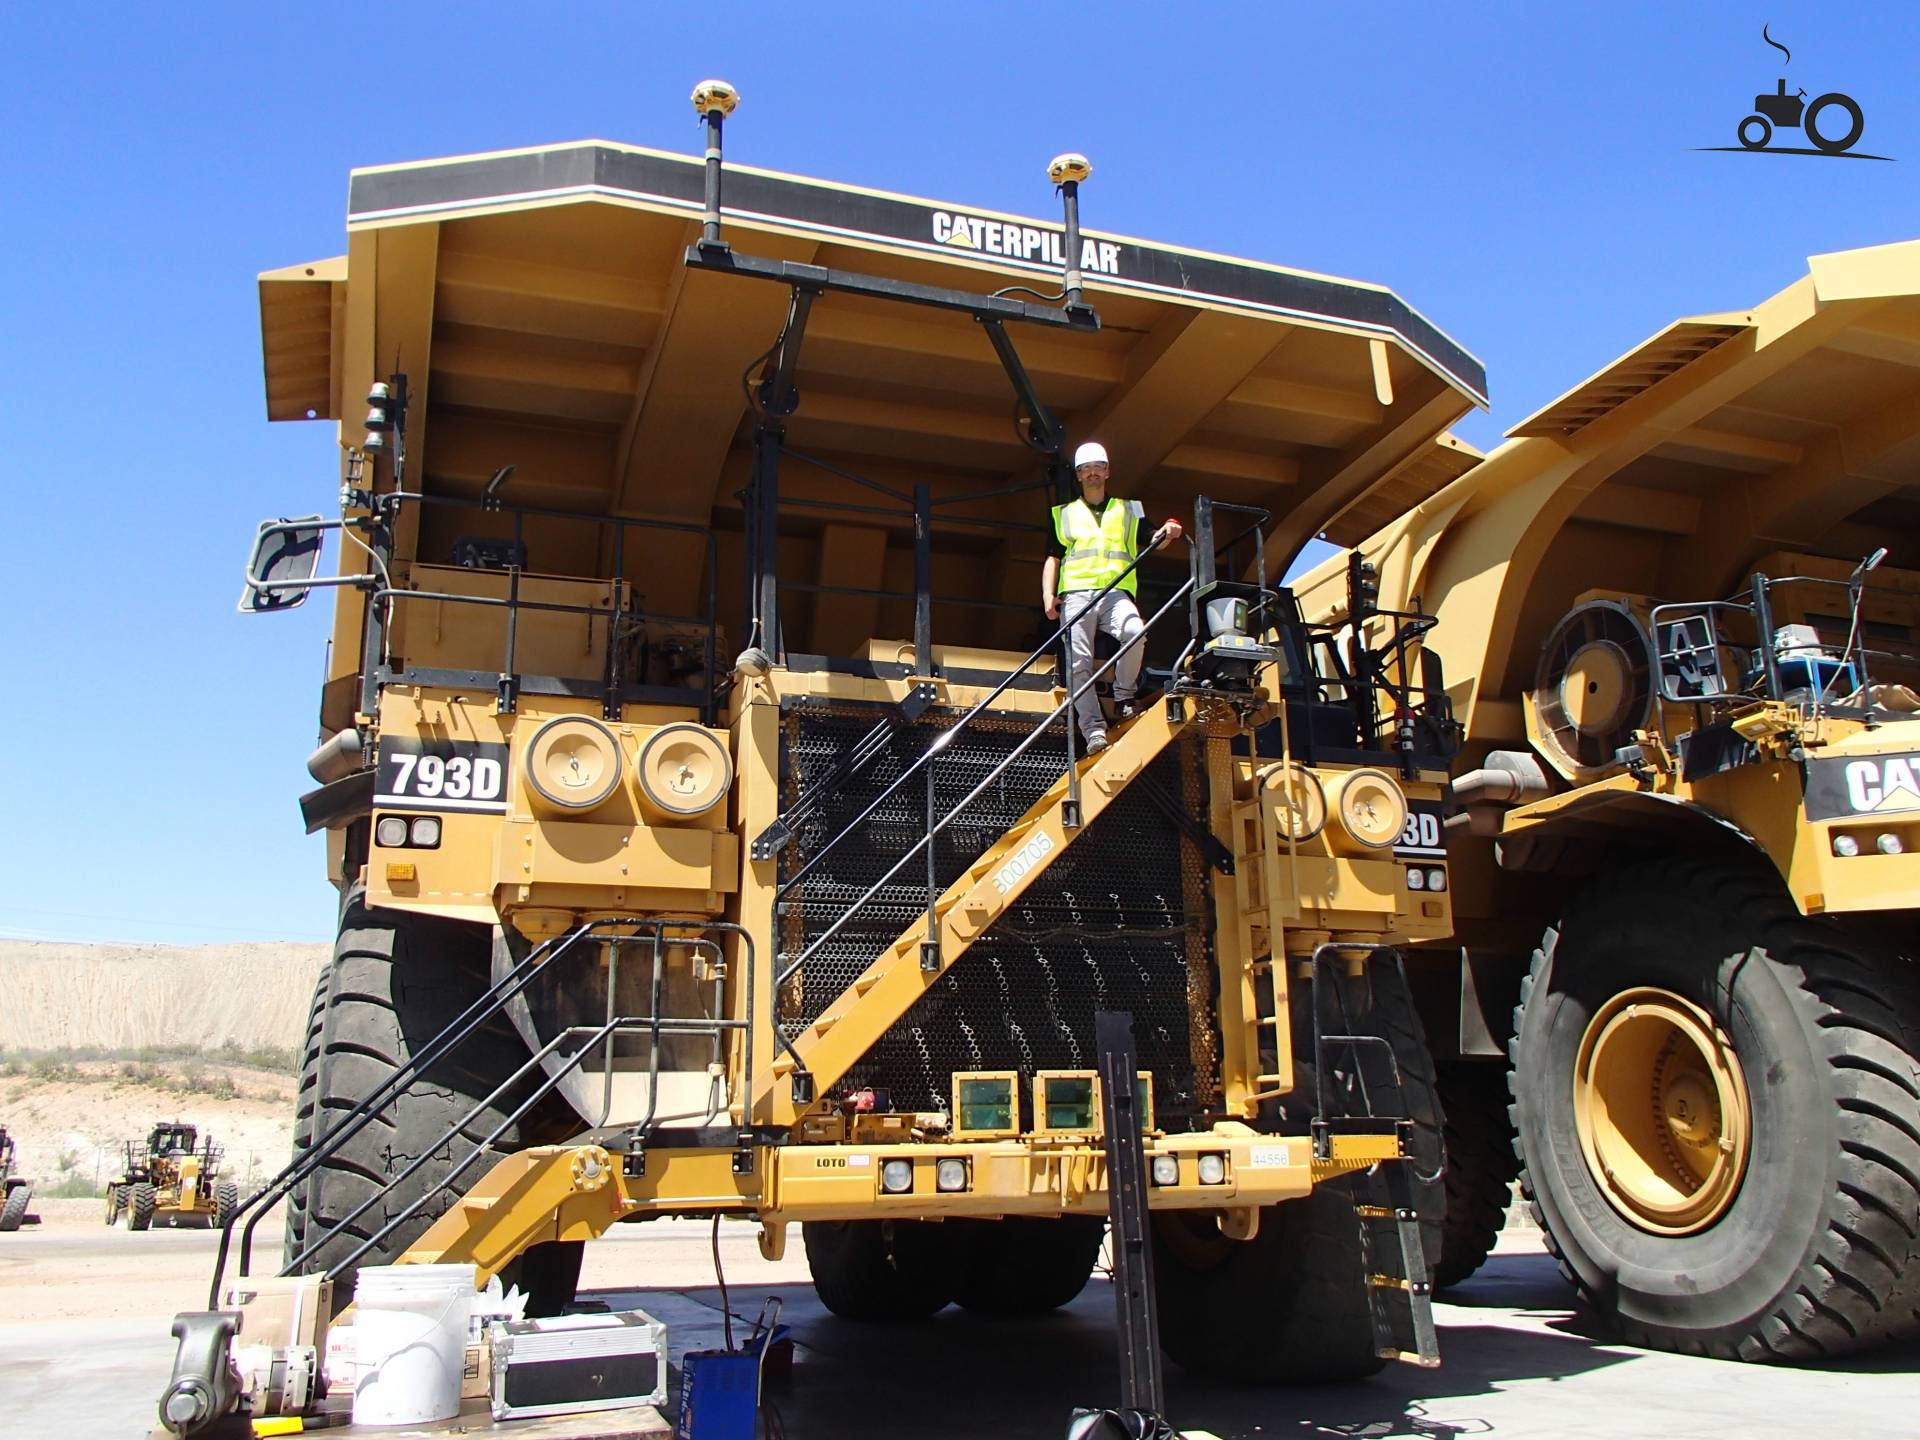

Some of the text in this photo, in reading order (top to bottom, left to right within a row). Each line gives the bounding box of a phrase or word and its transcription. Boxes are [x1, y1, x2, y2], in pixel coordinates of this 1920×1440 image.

[932, 211, 1120, 275] CATERPILAR
[390, 753, 501, 799] 793D
[1394, 812, 1439, 846] 3D
[992, 832, 1051, 895] 300705
[816, 1158, 846, 1168] LOTO
